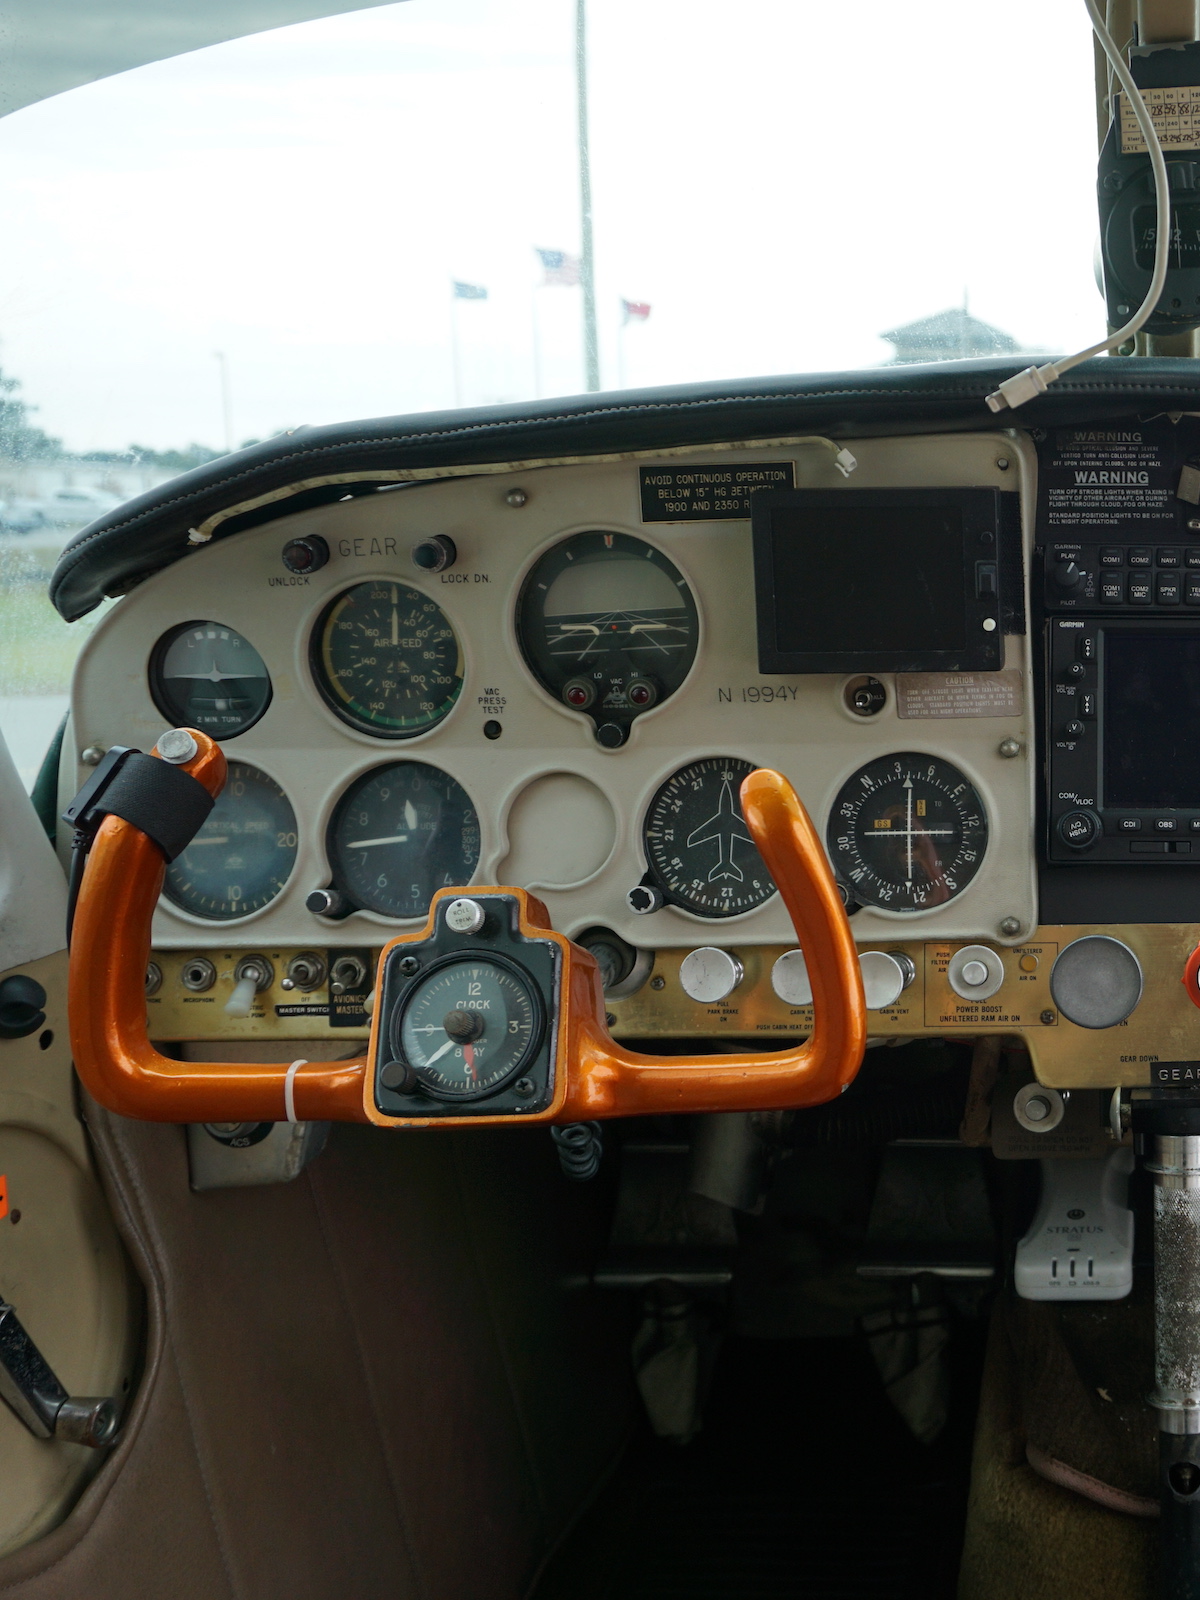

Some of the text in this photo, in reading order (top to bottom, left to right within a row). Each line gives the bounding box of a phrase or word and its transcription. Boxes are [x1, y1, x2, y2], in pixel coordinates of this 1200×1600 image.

[1074, 432, 1142, 441] WARNING
[645, 471, 786, 485] AVOID CONTINUOUS OPERATION
[1074, 471, 1149, 483] WARNING
[658, 489, 690, 499] BELOW
[715, 487, 726, 496] HG
[665, 502, 687, 512] 1900
[692, 501, 709, 511] AND
[715, 500, 739, 510] 2350
[339, 538, 397, 556] GEAR
[268, 577, 310, 586] UNLOCK
[441, 574, 491, 583] LOCK DN.
[719, 686, 798, 702] N 1994Y
[483, 706, 503, 714] TEST
[691, 778, 703, 791] 27
[968, 814, 979, 827] 12
[277, 832, 296, 847] 20
[665, 829, 674, 841] 21
[468, 982, 481, 996] 12
[333, 995, 365, 1003] AVIONICS
[456, 1000, 490, 1010] CLOCK
[336, 1006, 364, 1014] MASTER
[230, 1138, 250, 1147] ACS
[1047, 1226, 1103, 1234] STRATUS
